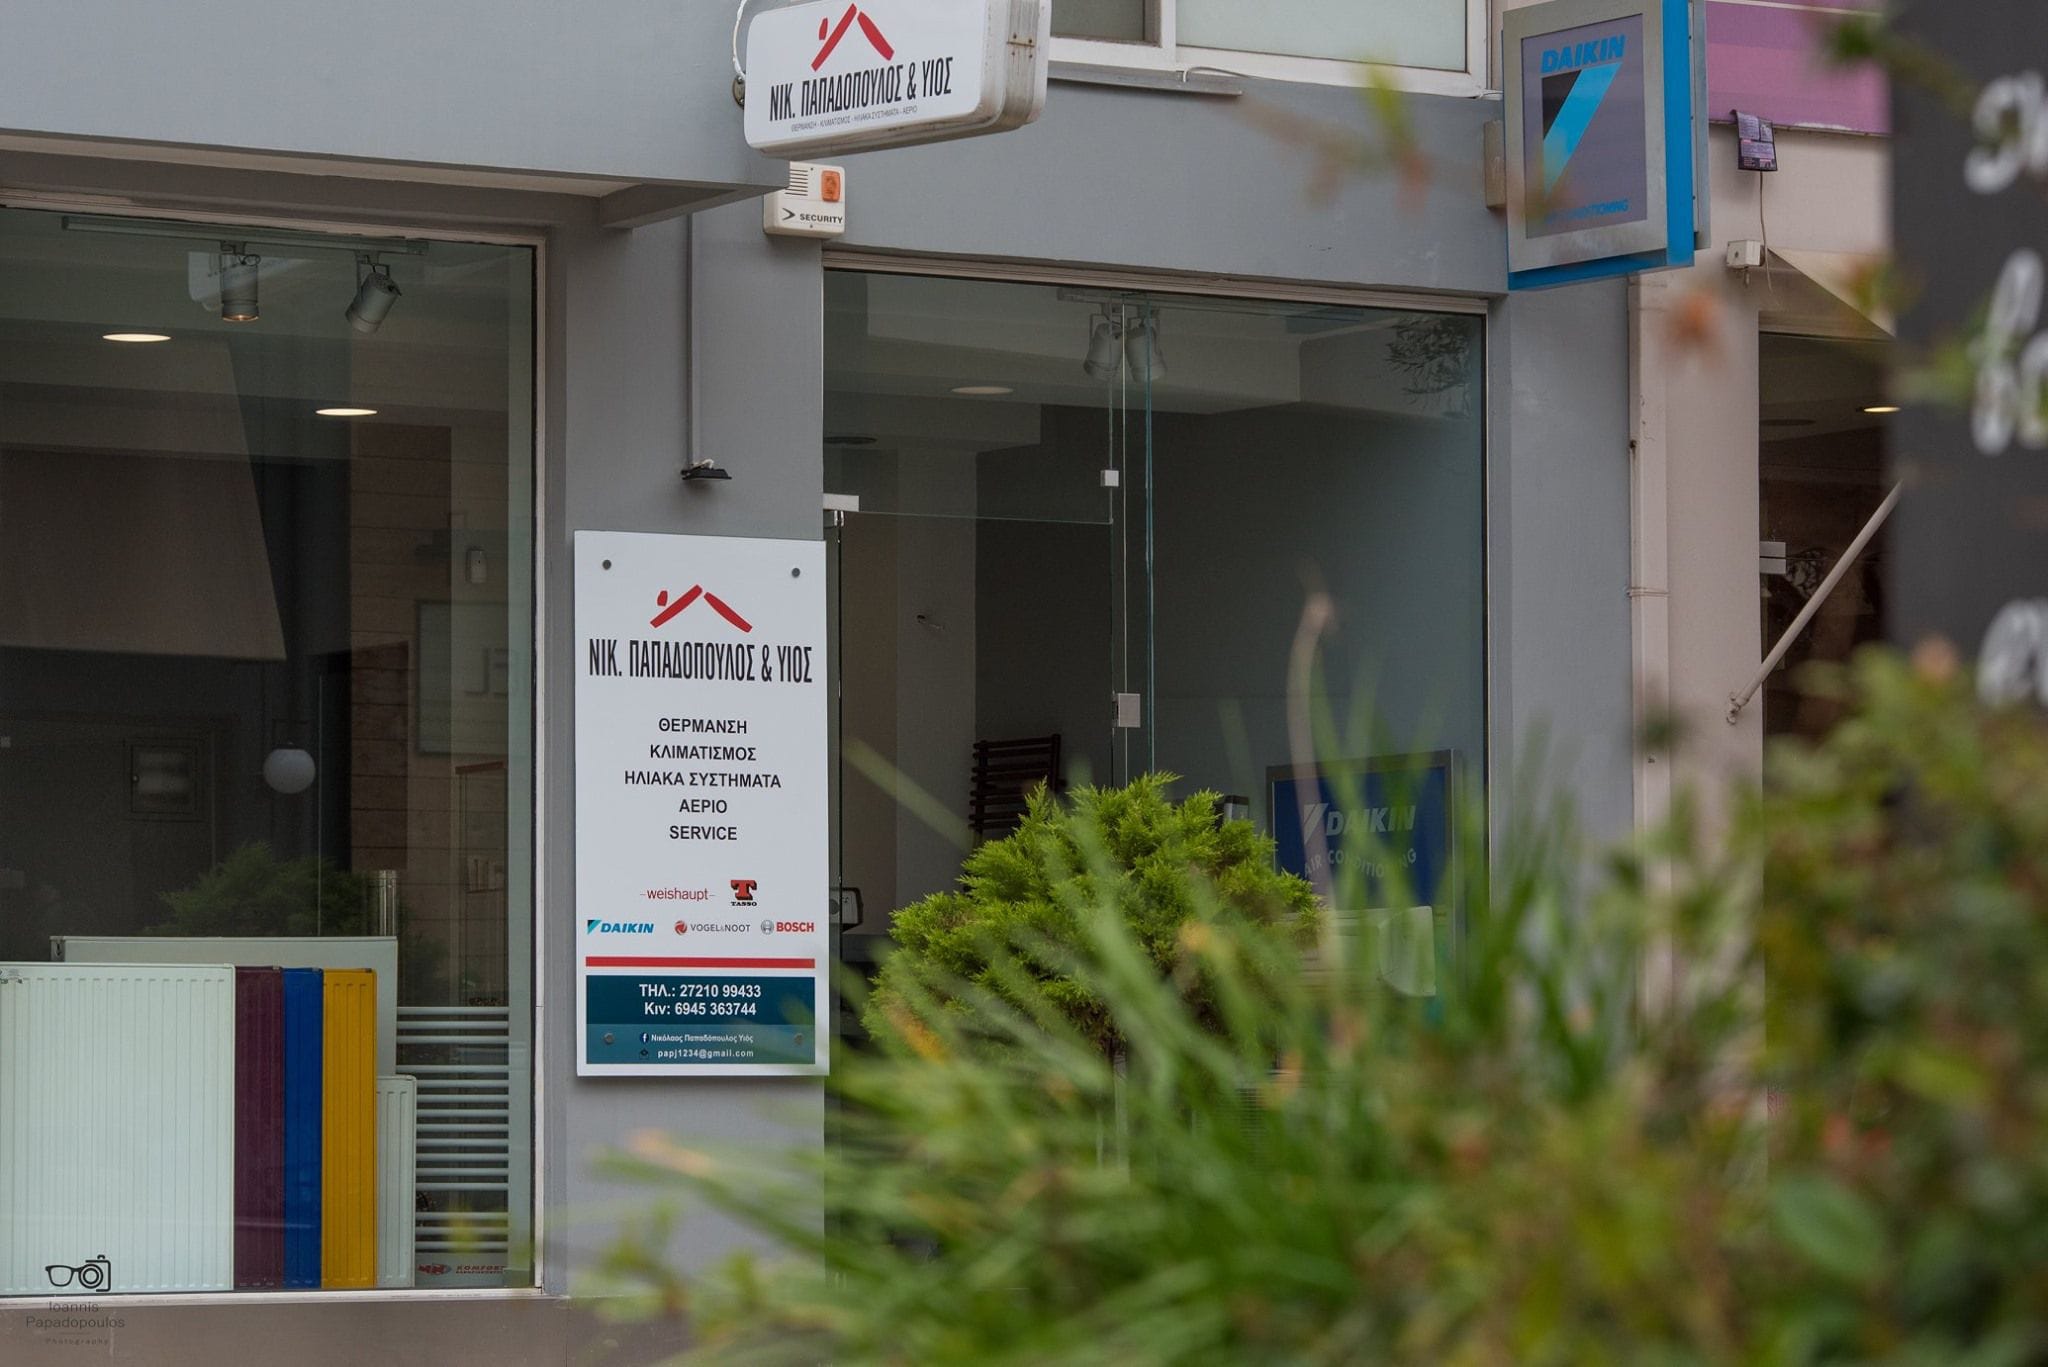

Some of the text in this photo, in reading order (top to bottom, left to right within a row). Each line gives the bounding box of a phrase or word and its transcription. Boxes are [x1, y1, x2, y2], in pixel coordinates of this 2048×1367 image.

[1541, 35, 1626, 73] DAIKIN
[769, 57, 953, 121] ΝΙΚ. ΠΑΠΑΔΟΠΟΥΛΟΣ & ΥΙΟΣ
[800, 213, 843, 224] SECURITY
[589, 638, 813, 683] ΝΙΚ. ΠΑΠΑΔΟΠΟΥΛΟΣ & ΥΙΟΣ
[659, 717, 747, 734] ΘΕΡΜΑΝΣΗ
[650, 744, 756, 761] ΚΛΙΜΑΤΙΣΜΟΣ
[625, 770, 781, 788] ΗΛΙΑΚΑ ΣΥΣΤΗΜΑΤΑ
[679, 799, 728, 813] ΑΕΡΙΟ
[669, 825, 737, 840] SERVICE
[600, 922, 655, 934] DAIKIN
[776, 921, 815, 932] BOSCH
[639, 983, 761, 998] ΤΗΛ.: 27210 99433
[644, 1002, 757, 1016] Κιν: 6945 363744
[657, 1049, 754, 1059] papj1234@gmail.com
